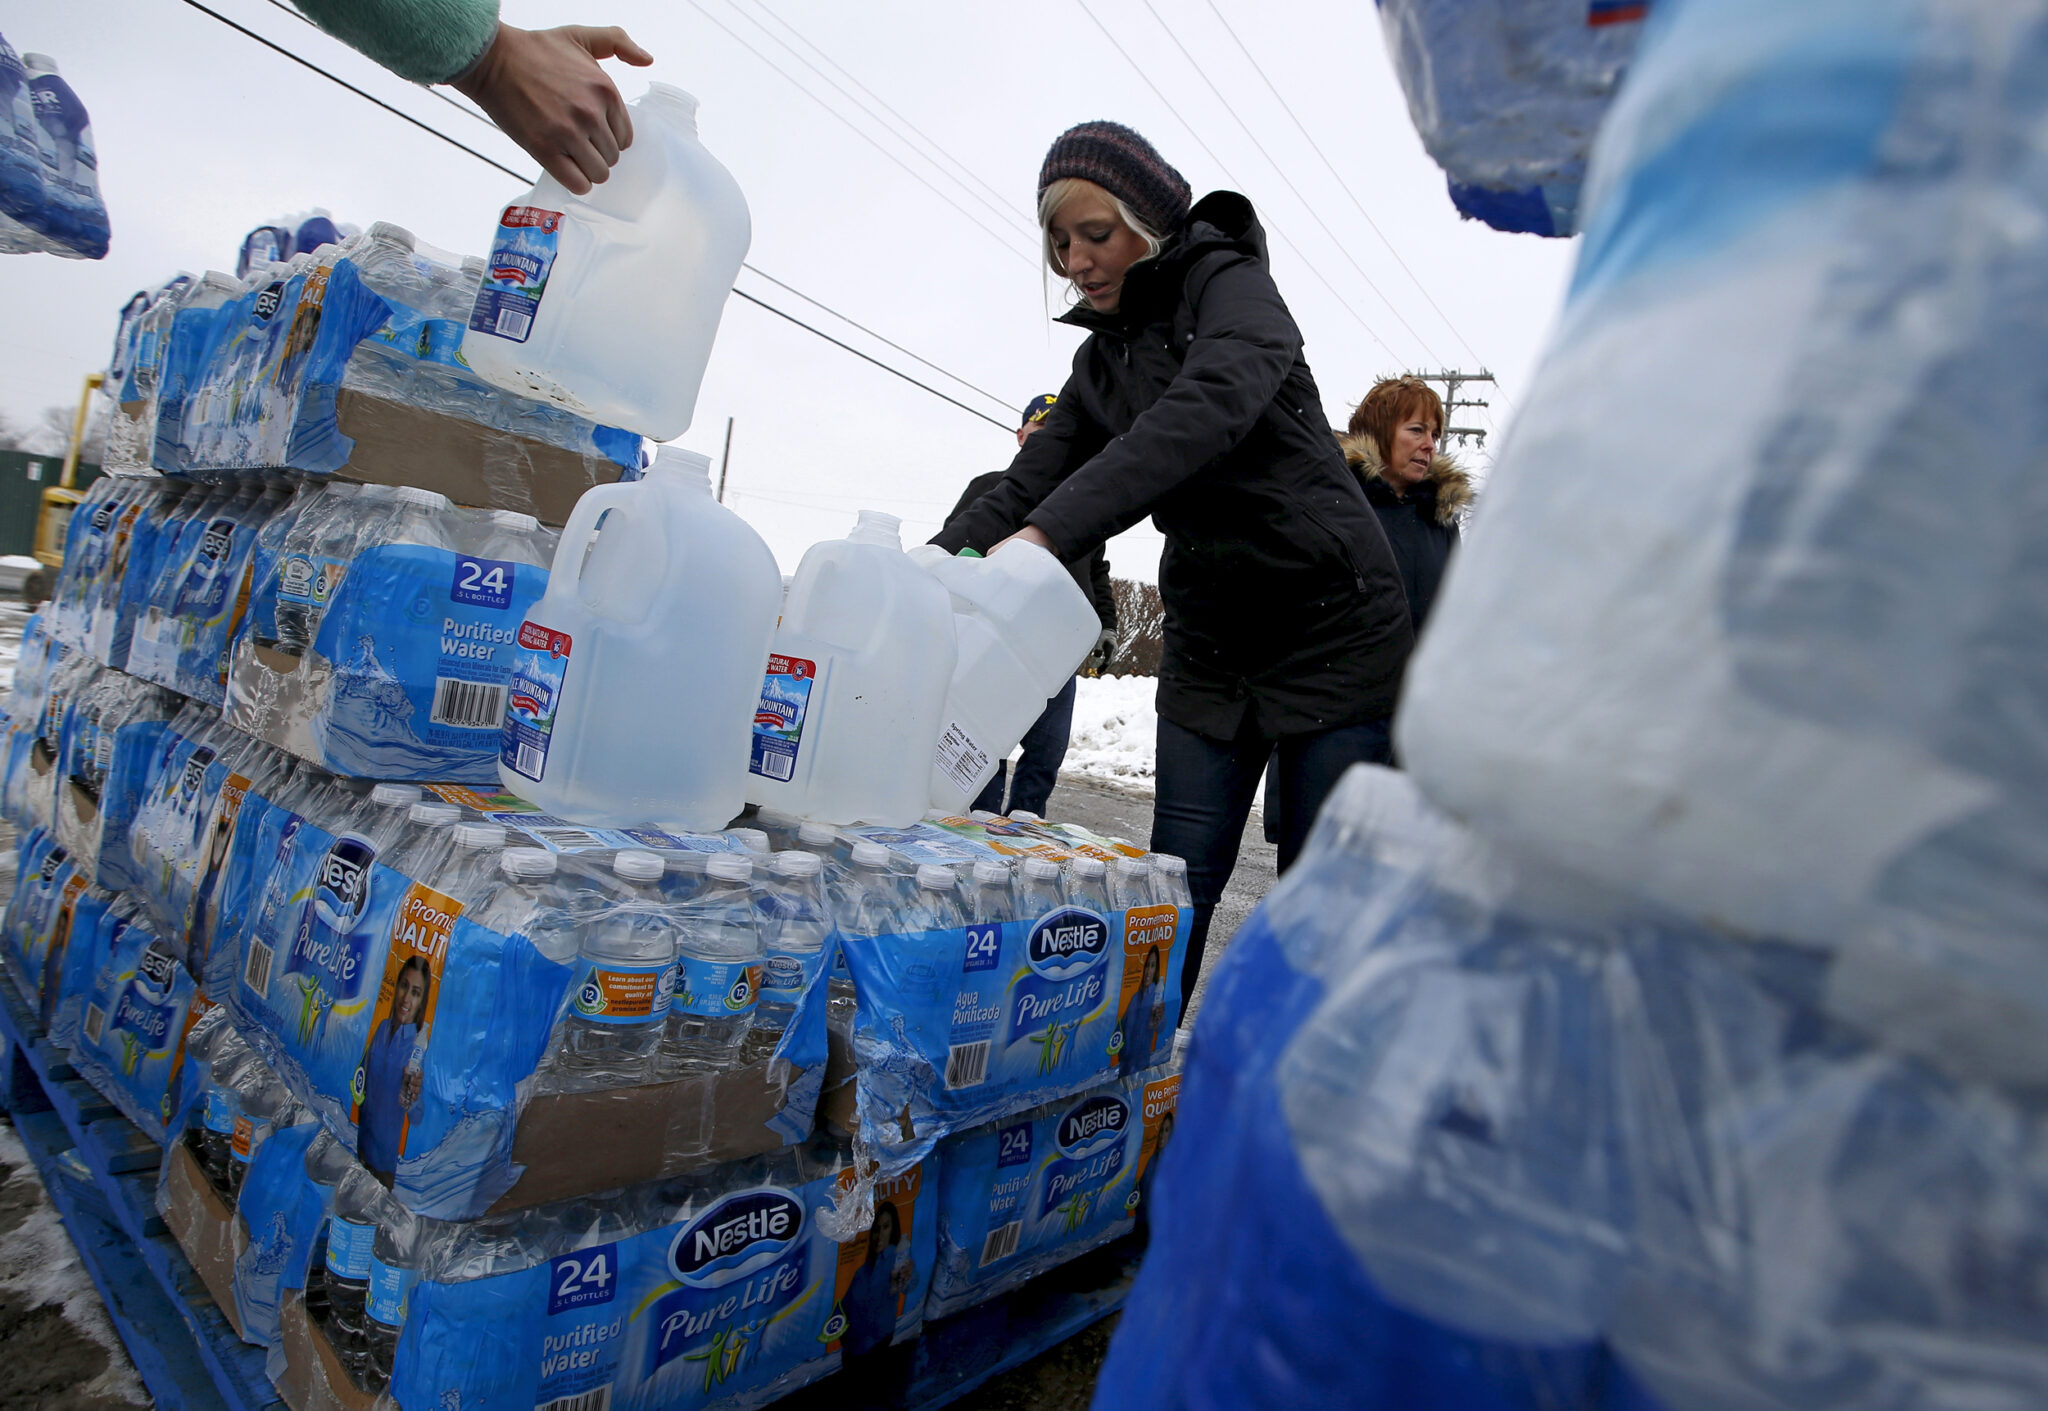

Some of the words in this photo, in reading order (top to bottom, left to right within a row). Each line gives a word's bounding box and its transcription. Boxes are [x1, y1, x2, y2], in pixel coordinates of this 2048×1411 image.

[502, 252, 539, 275] MOUNTAIN
[459, 561, 508, 595] 24
[471, 593, 506, 604] BOTTLES
[443, 617, 517, 645] Purified
[533, 627, 551, 641] NATURAL
[533, 637, 549, 650] WATER
[440, 636, 496, 660] Water
[553, 643, 561, 652] 16
[770, 664, 789, 674] WATER
[520, 678, 550, 705] MOUNTAIN
[759, 699, 796, 720] MOUNTAIN
[951, 723, 966, 741] Spring
[965, 737, 978, 752] Water
[410, 898, 456, 932] Promis
[395, 918, 449, 960] UALIT
[967, 930, 998, 959] 24
[1040, 923, 1100, 954] Nestlé
[1127, 925, 1173, 946] CALIDAD
[294, 922, 330, 966] Pure
[328, 942, 356, 981] Life
[608, 975, 626, 983] Learn
[585, 989, 594, 1000] 12
[625, 991, 645, 999] quality
[736, 988, 744, 997] 12
[955, 991, 978, 1010] Agua
[1016, 994, 1063, 1027] Pure
[1065, 973, 1101, 1009] Life
[116, 994, 147, 1026] Pure
[144, 1009, 166, 1038] Life
[952, 1003, 1001, 1025] Purificada
[1147, 1089, 1162, 1101] We
[1069, 1104, 1121, 1140] Nestlé
[1001, 1128, 1029, 1157] 24
[991, 1172, 1031, 1197] Purifid
[1047, 1167, 1090, 1203] Pure
[1090, 1149, 1121, 1177] Life
[990, 1195, 1016, 1213] Wate
[694, 1203, 790, 1261] Nestlé
[557, 1254, 612, 1297] 24
[571, 1289, 610, 1303] BOTTLES
[660, 1294, 738, 1351] Pure
[740, 1263, 800, 1312] Life
[543, 1315, 623, 1357] Purified
[541, 1349, 601, 1379] Water
